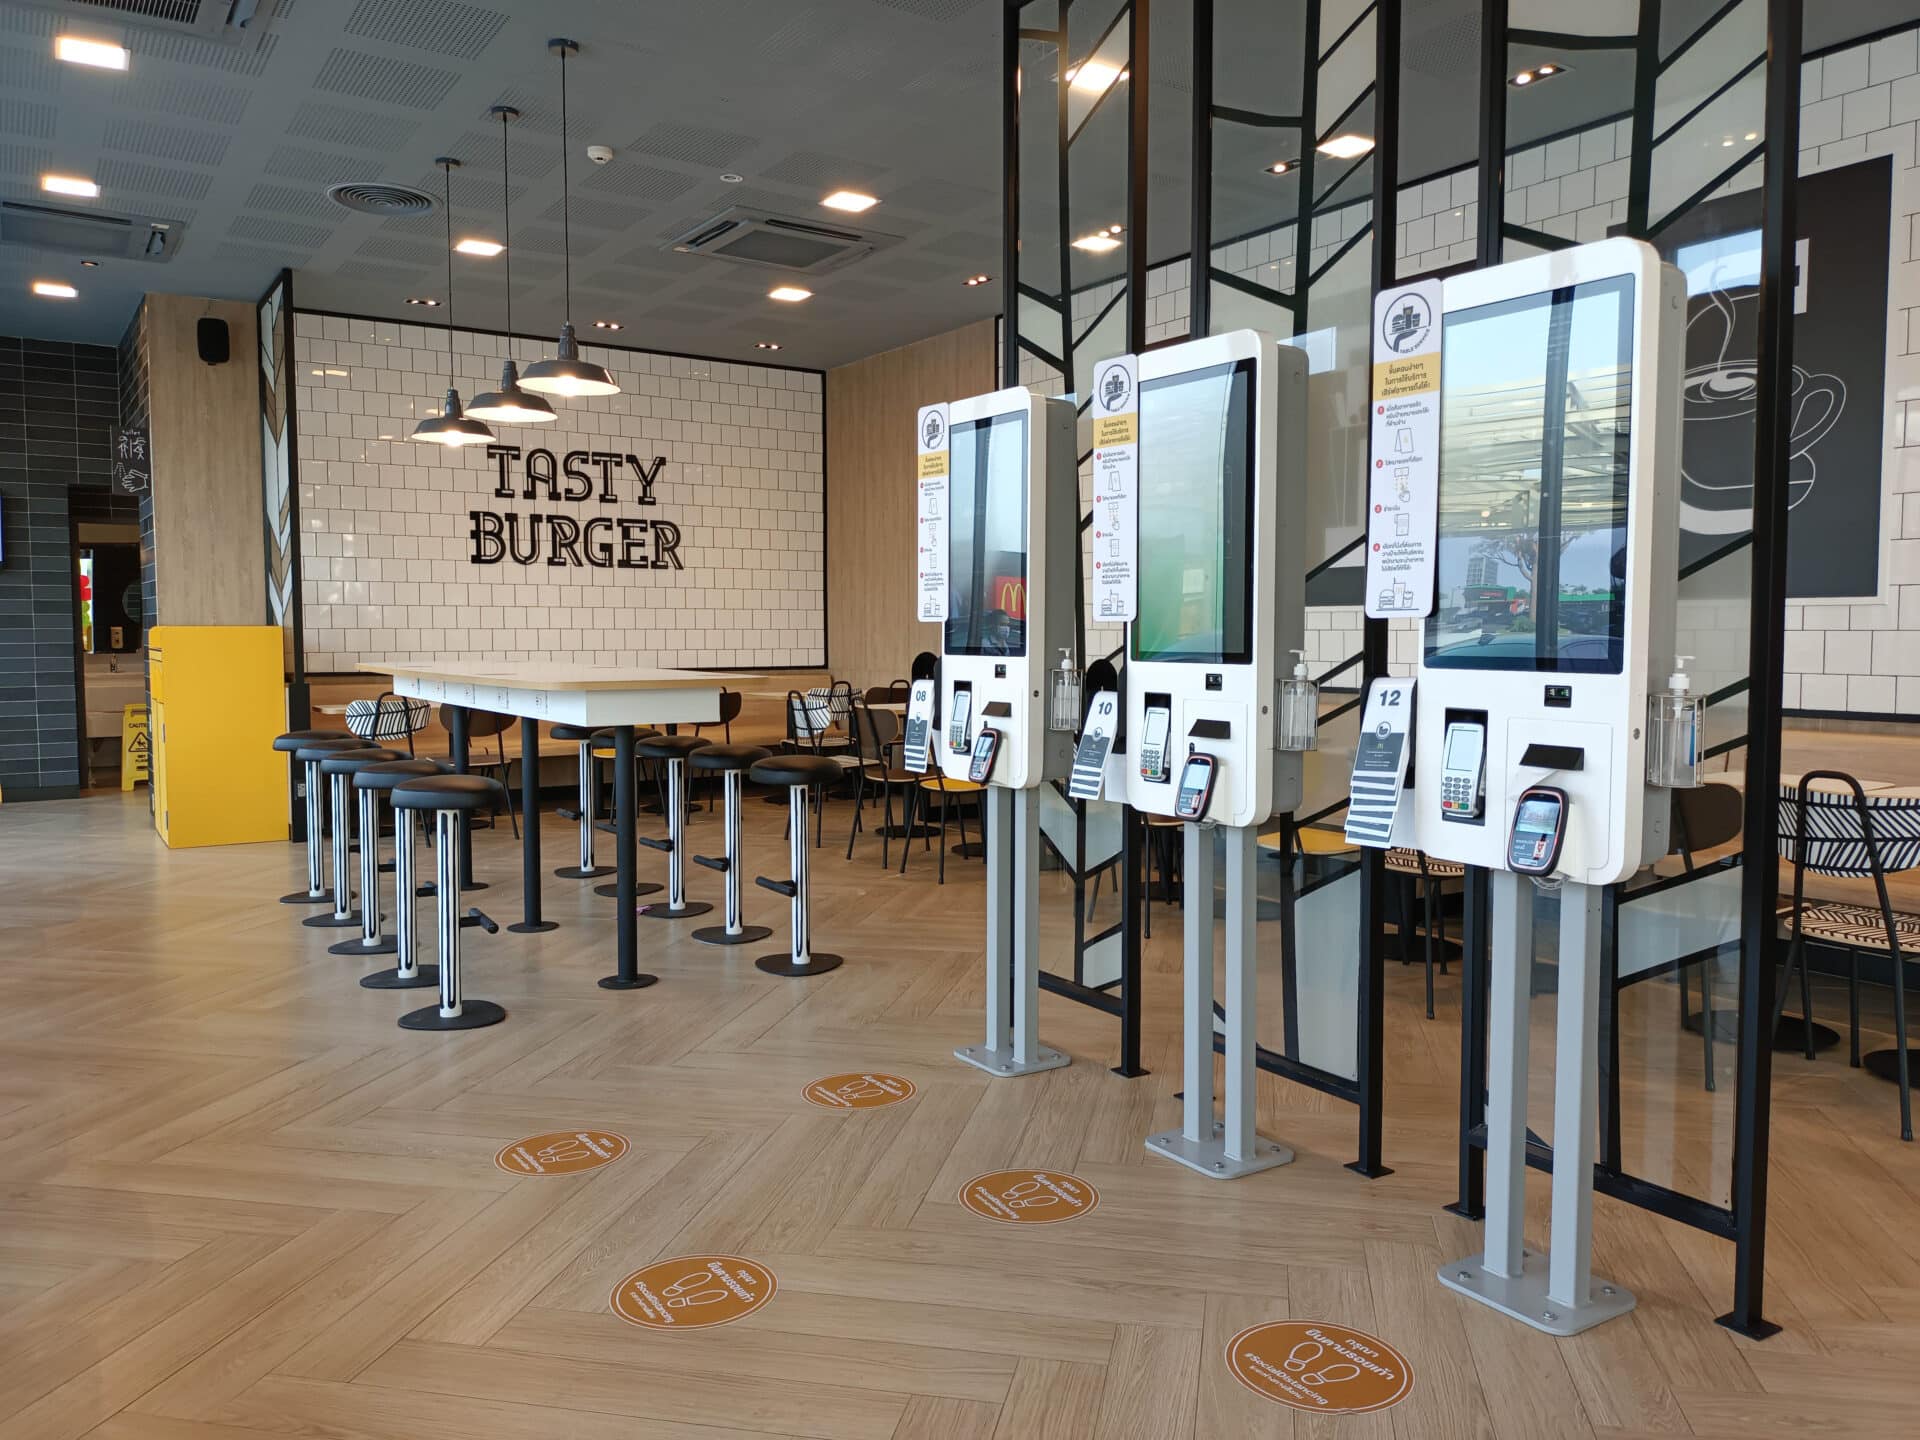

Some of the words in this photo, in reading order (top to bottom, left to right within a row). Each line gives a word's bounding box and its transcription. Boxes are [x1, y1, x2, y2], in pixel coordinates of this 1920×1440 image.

[487, 445, 666, 505] TASTY
[470, 511, 684, 570] BURGER
[915, 690, 927, 702] 08
[1379, 689, 1401, 707] 12
[1098, 701, 1113, 716] 10
[1305, 1328, 1396, 1381] ยืนตามรอยเท้า
[1345, 1338, 1380, 1359] กรุณา
